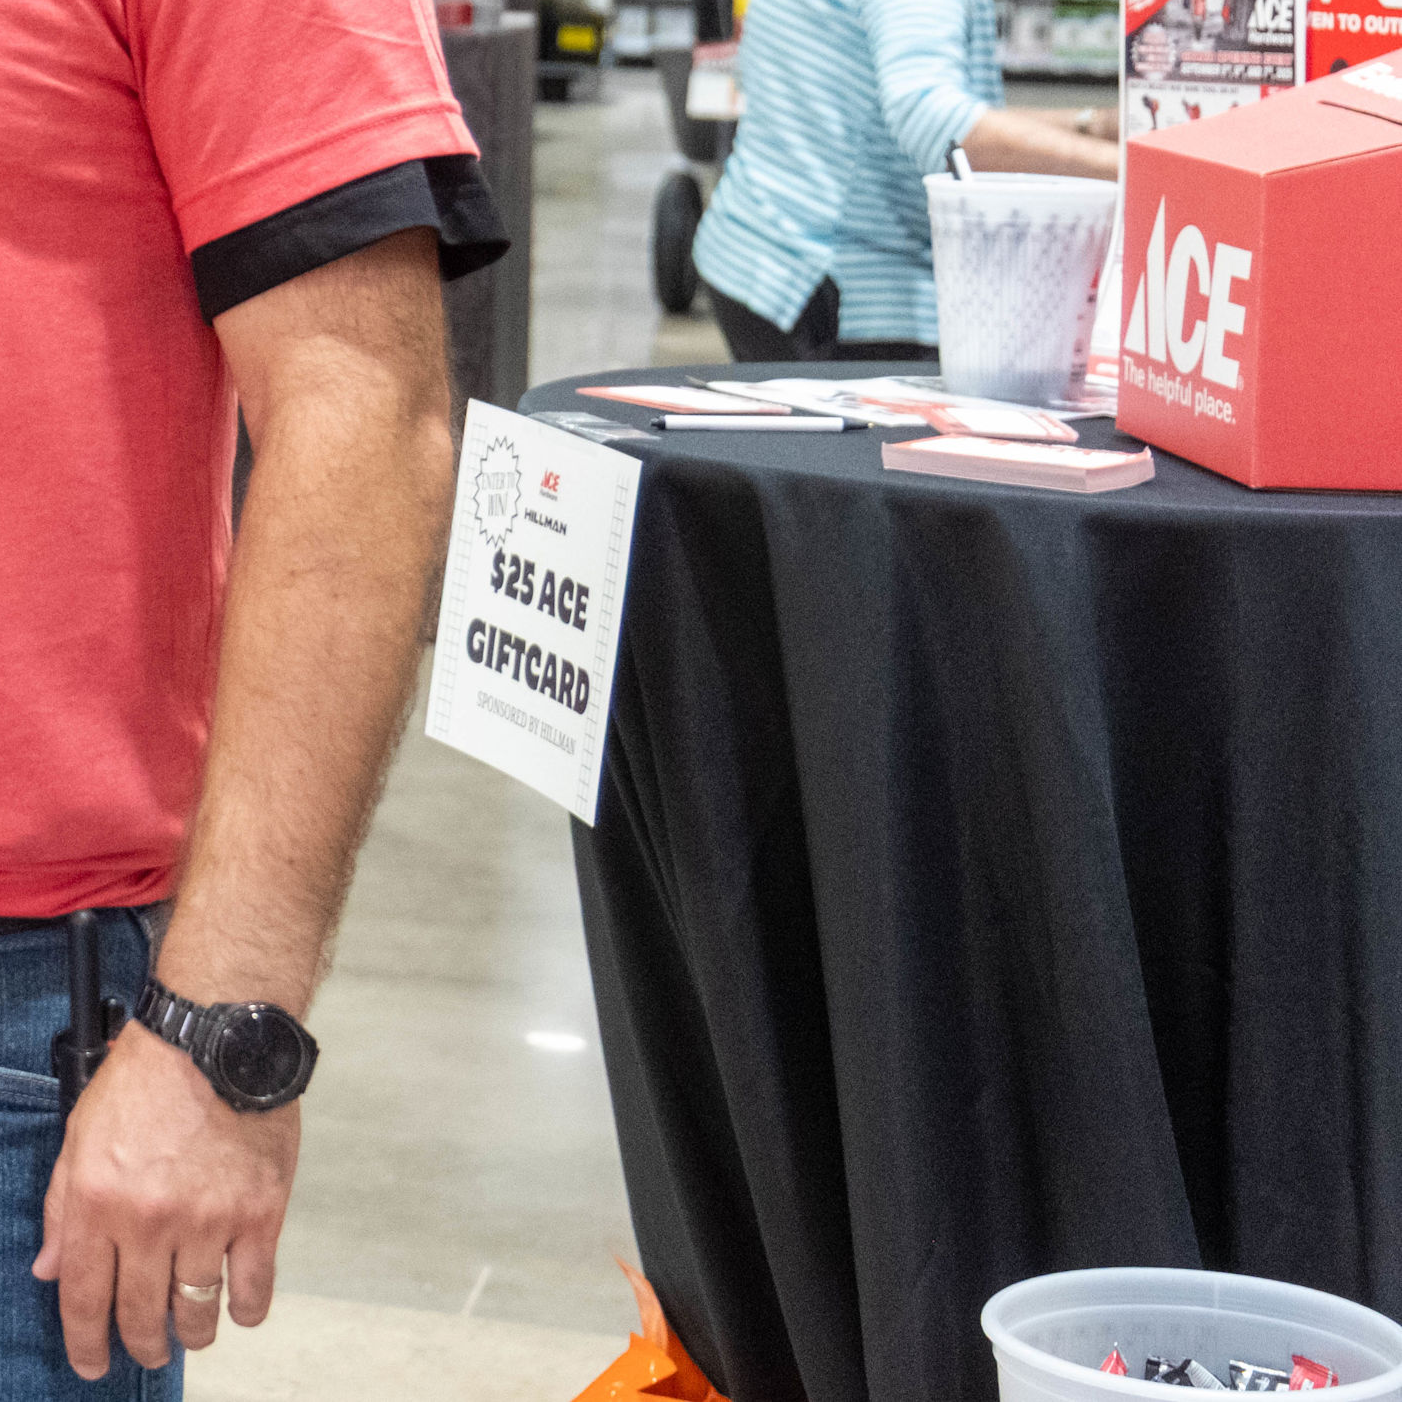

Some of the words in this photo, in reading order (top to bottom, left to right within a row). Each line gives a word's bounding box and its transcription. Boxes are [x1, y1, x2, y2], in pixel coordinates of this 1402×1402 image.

[1337, 12, 1361, 32] TO
[1123, 193, 1254, 390] ACE
[1122, 353, 1146, 390] The
[1147, 365, 1192, 408] helpful
[1194, 388, 1237, 425] place.
[540, 467, 560, 493] ACE
[524, 507, 568, 537] HILLMAN
[490, 547, 535, 607] $25
[537, 567, 590, 633] ACE
[466, 617, 590, 715] GIFTCARD
[477, 690, 528, 729] SPONSORED
[529, 715, 541, 735] BY
[540, 721, 576, 756] HILLMAN
